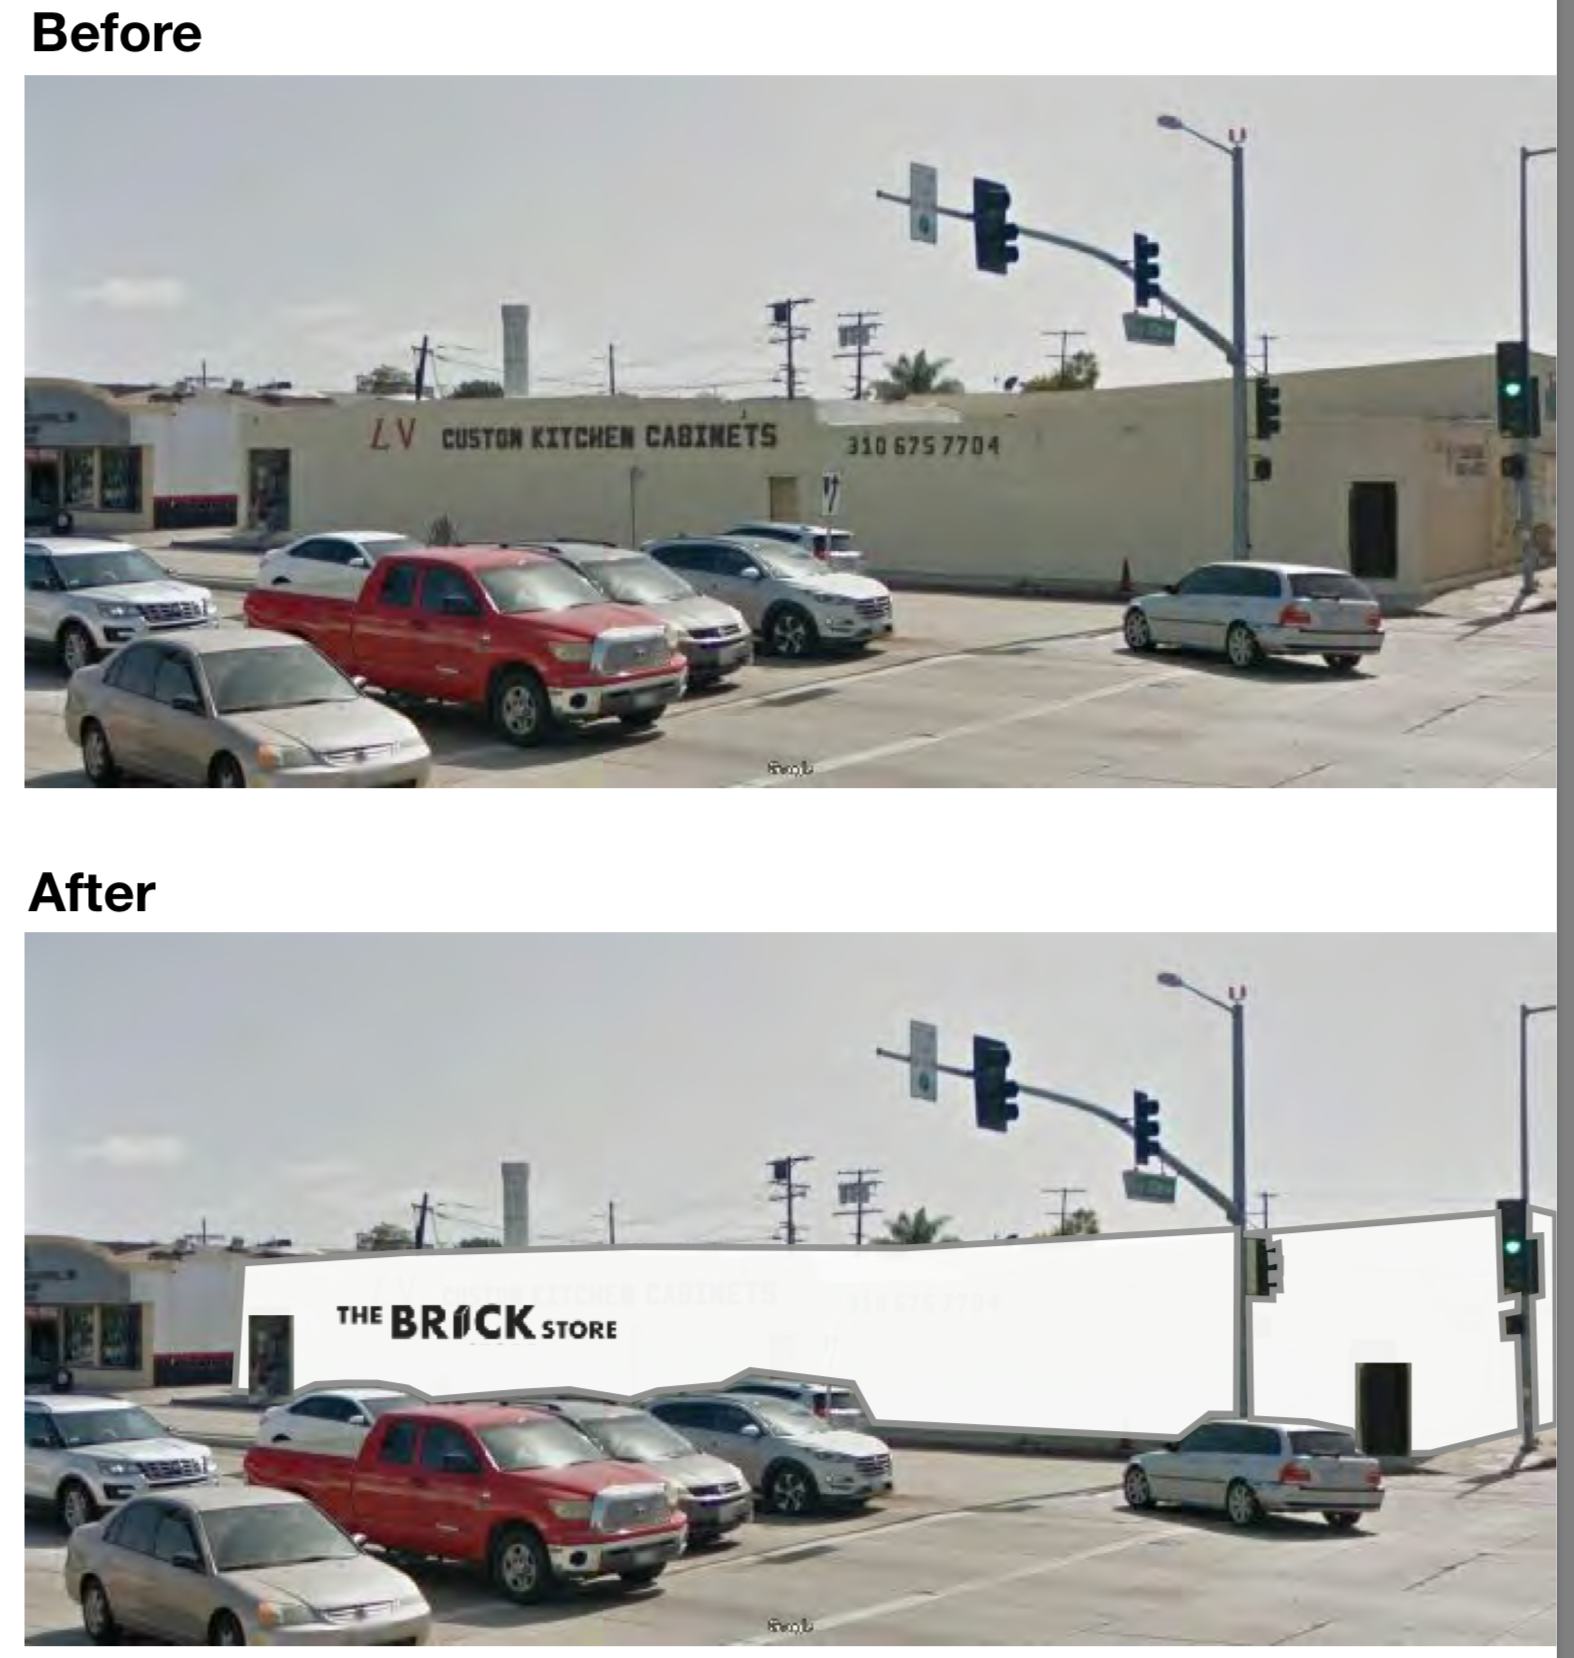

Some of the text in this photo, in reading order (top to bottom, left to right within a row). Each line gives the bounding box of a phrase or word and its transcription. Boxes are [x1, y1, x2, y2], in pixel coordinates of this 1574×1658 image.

[531, 424, 636, 450] KITCHEN
[645, 421, 778, 449] CABINETS
[847, 434, 1000, 457] 310 675 7704
[336, 1304, 617, 1340] THE BRICK STORE
